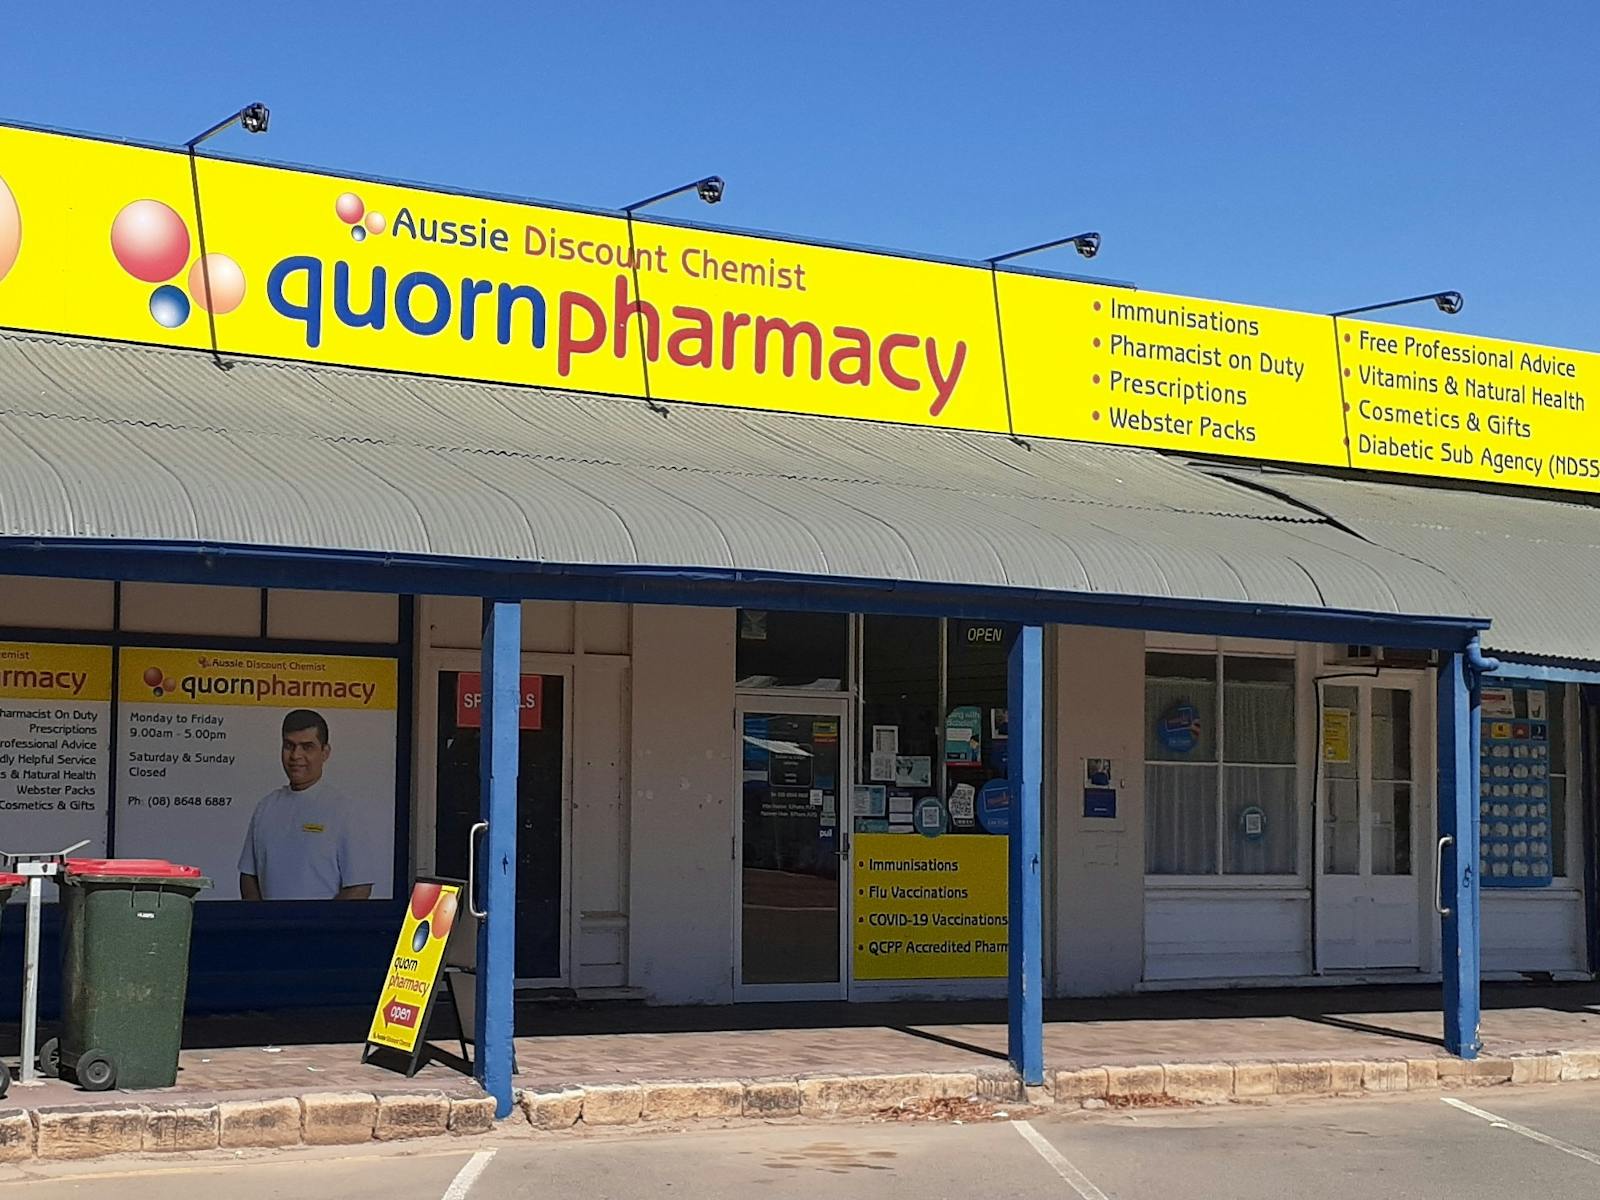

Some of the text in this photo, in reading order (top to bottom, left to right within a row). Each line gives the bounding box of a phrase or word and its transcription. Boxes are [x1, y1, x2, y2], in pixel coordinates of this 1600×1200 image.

[392, 207, 807, 291] Aussie Discount Chemist
[1111, 297, 1259, 336] Immunisations
[1110, 333, 1304, 382] Pharmacist on Duty
[1359, 330, 1576, 378] Free Professional Advice
[1110, 371, 1247, 405] Prescriptions
[1358, 364, 1585, 412] Vitamins & Natural Health
[1110, 406, 1256, 442] Webster Packs
[1358, 399, 1531, 438] Cosmetics & Gifts
[1358, 433, 1600, 480] Diabetic Sub Agency (NDSS
[967, 627, 1003, 642] OPEN
[0, 650, 30, 660] emist
[212, 658, 326, 672] Aussie Discount Chemist
[2, 669, 87, 695] rmacy
[464, 693, 535, 708] SPLS
[0, 708, 98, 722] harmacist On Duty
[129, 712, 224, 727] Monday to Friday
[29, 723, 97, 736] Prescriptions
[129, 728, 173, 739] 9.00am
[0, 738, 97, 750] rofessional Advice
[0, 754, 97, 766] dly Helpful Service
[129, 751, 235, 765] Saturday & Sunday
[10, 769, 20, 779] &
[23, 769, 61, 780] Natural
[63, 770, 97, 780] Health
[129, 767, 166, 778] Closed
[16, 785, 96, 796] Webster Packs
[57, 800, 66, 810] &
[69, 800, 95, 811] Gifts
[148, 796, 170, 808] (08)
[174, 796, 201, 806] 8648
[205, 796, 232, 807] 6887
[869, 858, 959, 871] Immunisations
[869, 885, 968, 899] Flu Vaccinations
[869, 913, 1008, 926] COVID-19 Vaccinations
[869, 940, 1008, 955] QCPP Accredited Pharm
[388, 972, 430, 997] pharmacy
[390, 1006, 411, 1022] open
